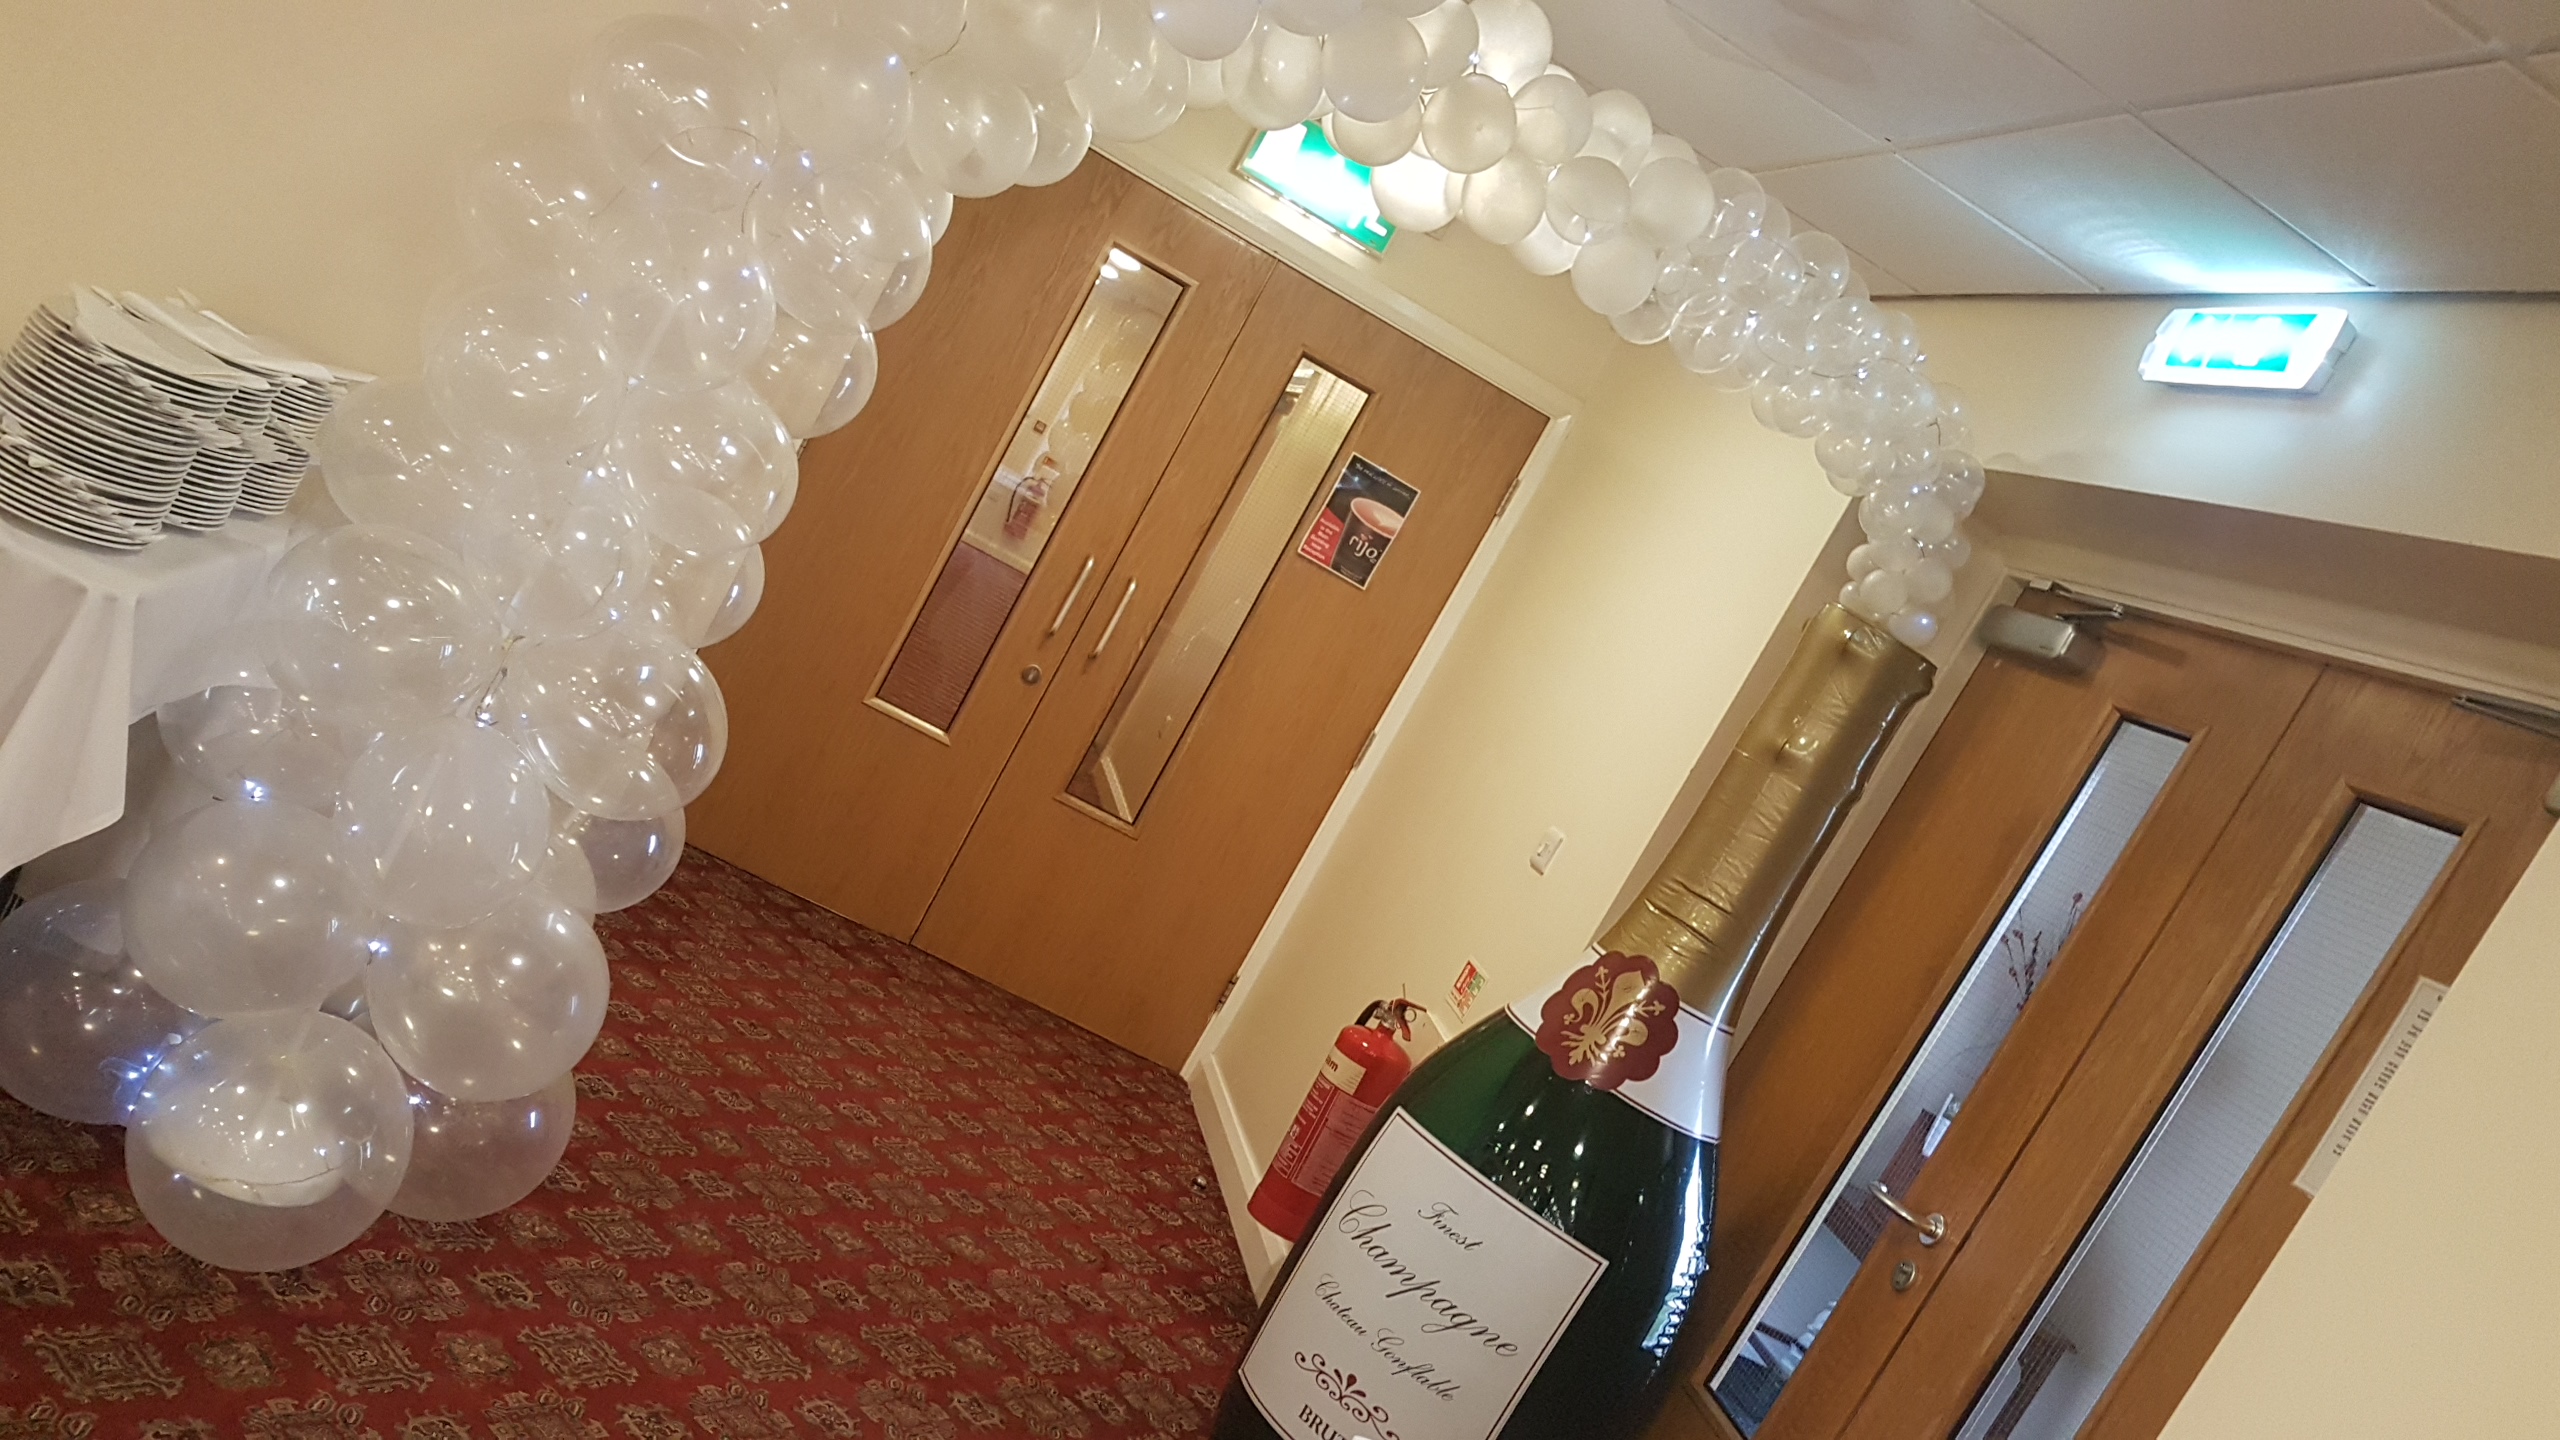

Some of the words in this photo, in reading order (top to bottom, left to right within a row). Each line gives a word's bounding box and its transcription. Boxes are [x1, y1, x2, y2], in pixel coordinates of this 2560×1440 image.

[1339, 1189, 1519, 1357] Champagne
[1417, 1201, 1484, 1251] Finest
[1315, 1273, 1367, 1336] Chateau
[1370, 1328, 1461, 1401] Gonflable
